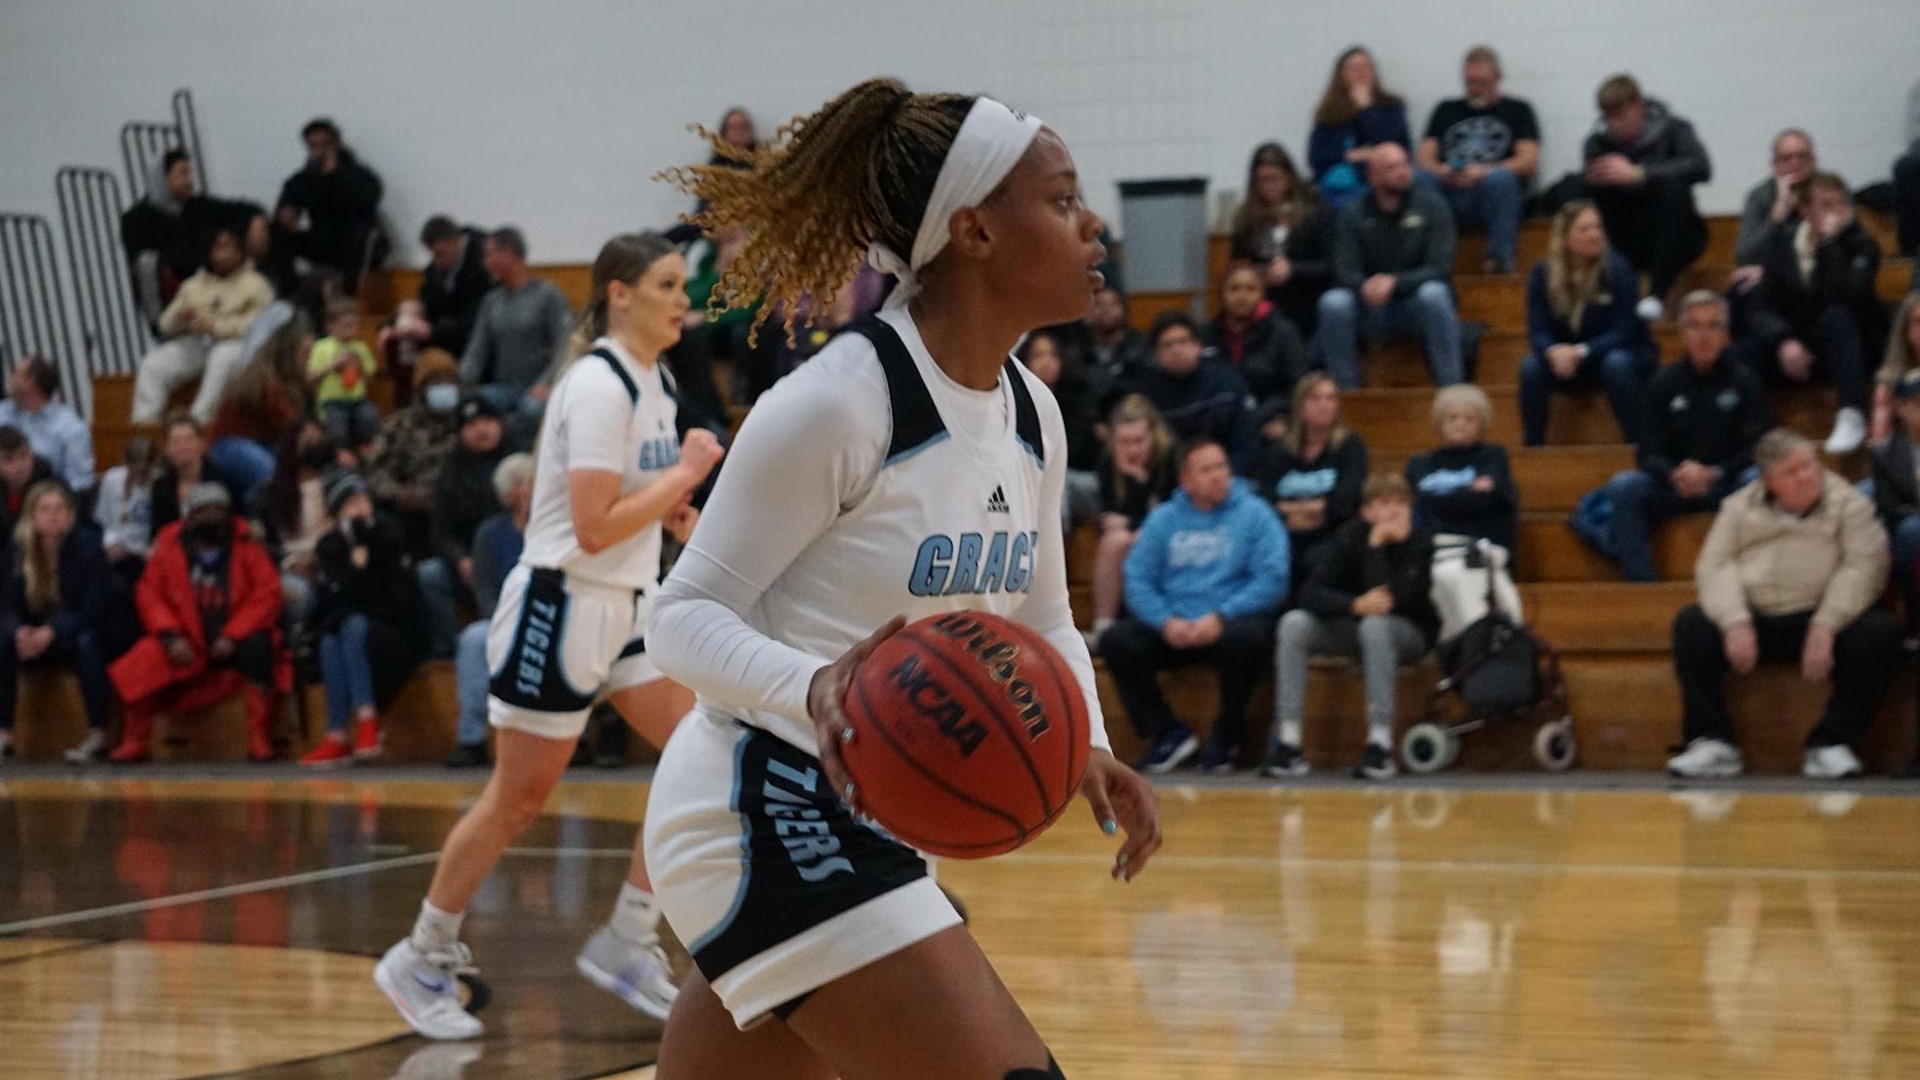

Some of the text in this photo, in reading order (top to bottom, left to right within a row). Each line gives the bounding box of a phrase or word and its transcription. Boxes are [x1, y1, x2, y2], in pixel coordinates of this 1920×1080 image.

[908, 531, 1038, 596] GRAC
[515, 599, 557, 697] TIGERS
[931, 612, 1050, 743] Wilson
[886, 653, 988, 758] NCAA
[762, 757, 856, 882] TIGERS
